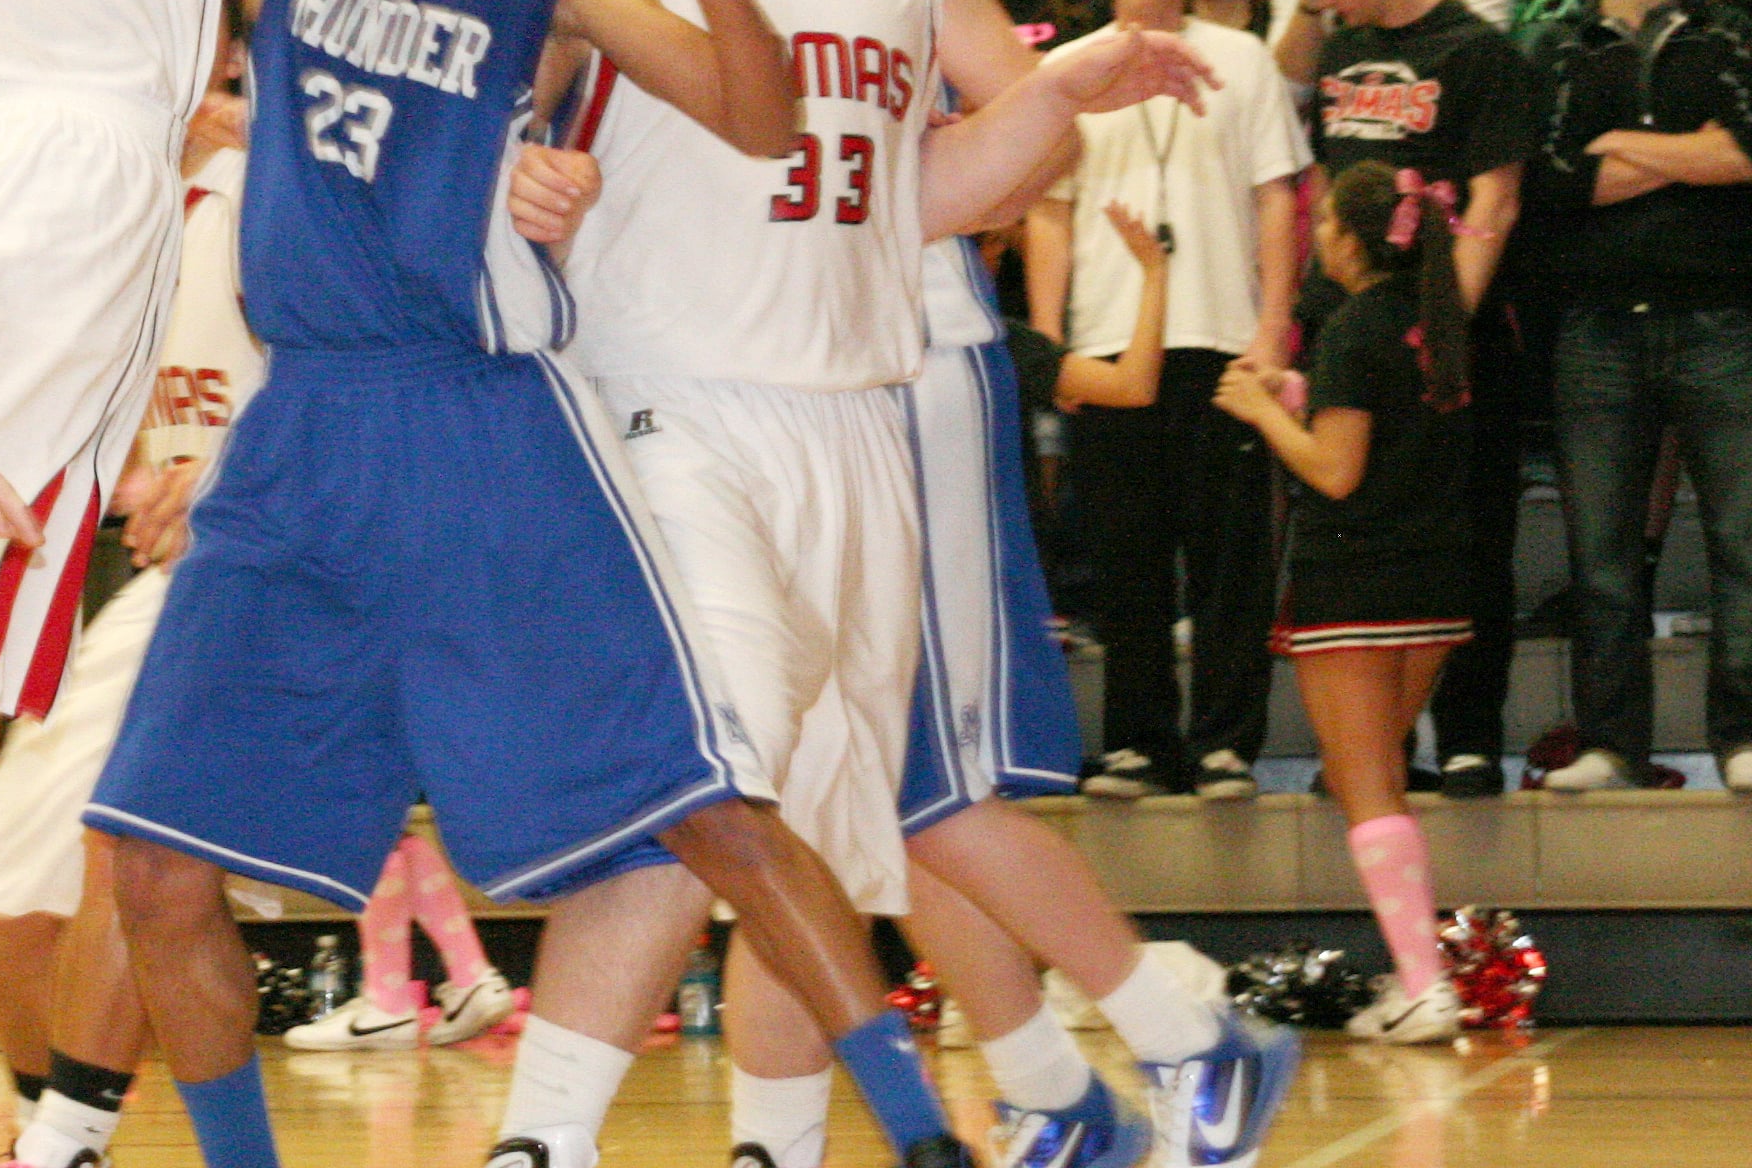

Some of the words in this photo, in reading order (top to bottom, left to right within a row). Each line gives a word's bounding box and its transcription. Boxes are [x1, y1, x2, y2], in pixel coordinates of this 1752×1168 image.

[791, 31, 914, 122] MAS
[304, 72, 393, 185] 23
[768, 132, 875, 226] 33
